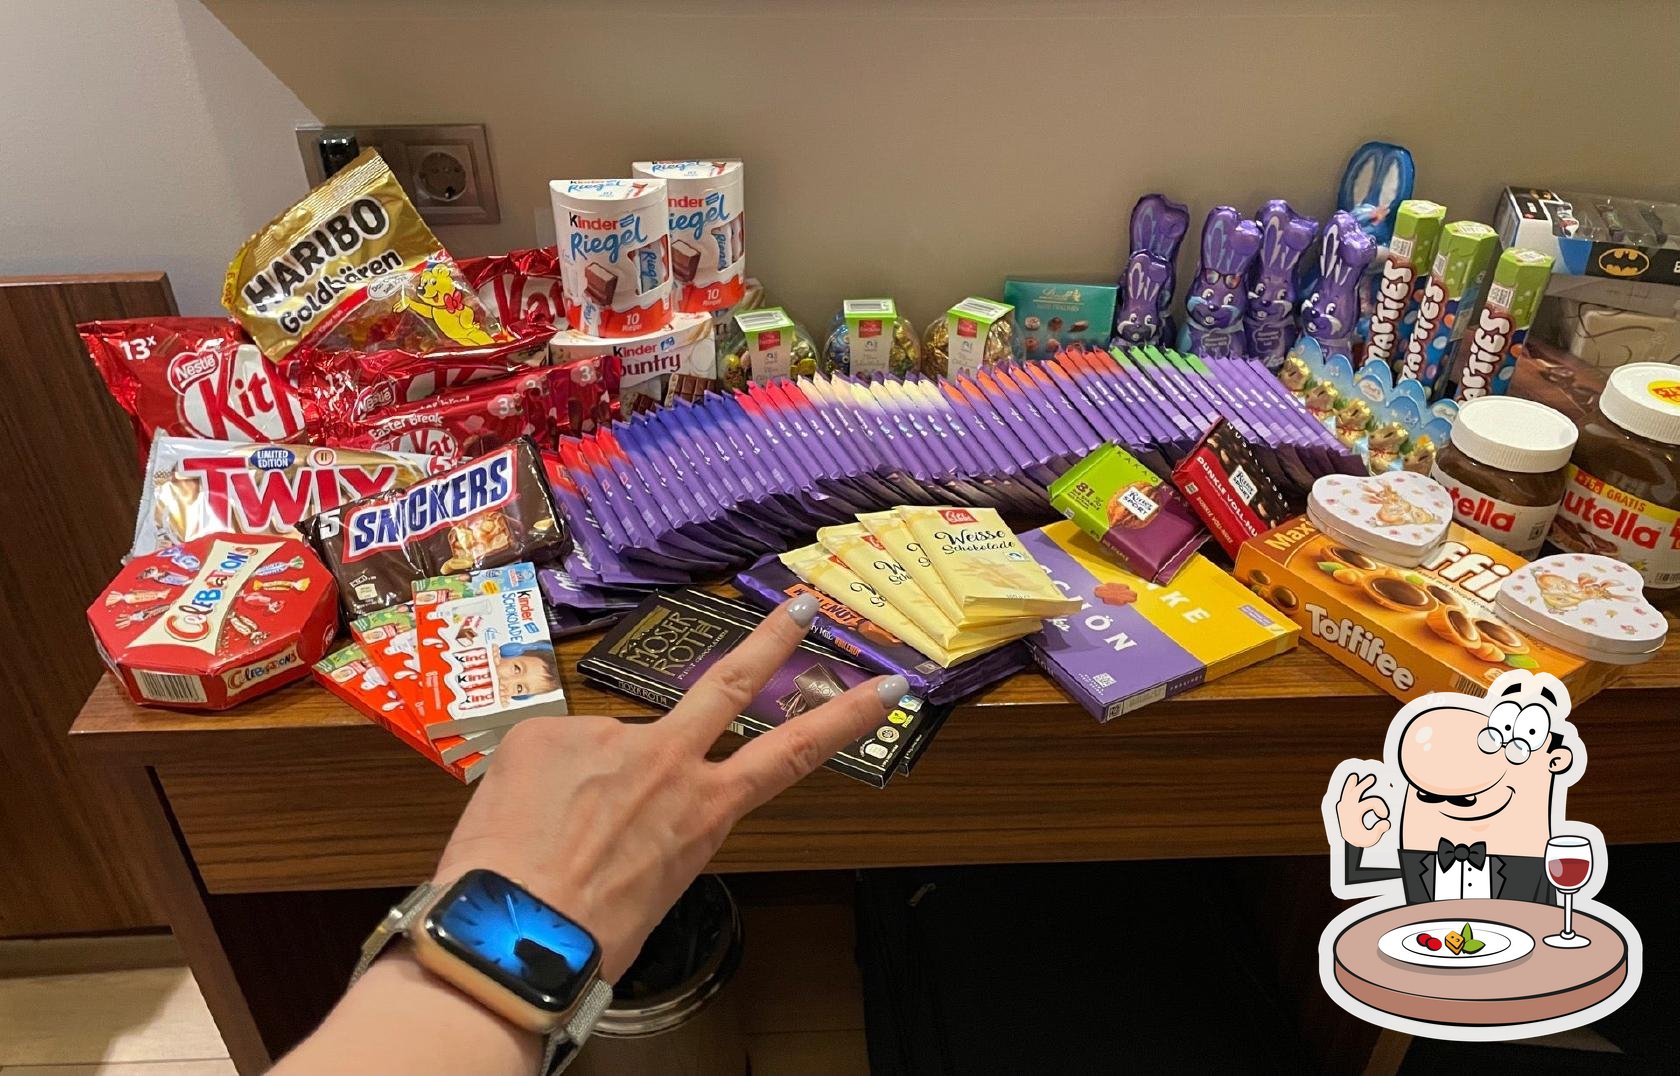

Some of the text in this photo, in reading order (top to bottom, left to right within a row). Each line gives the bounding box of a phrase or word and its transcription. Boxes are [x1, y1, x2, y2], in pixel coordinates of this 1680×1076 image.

[668, 196, 704, 208] nder
[668, 193, 730, 240] iegel
[244, 198, 388, 312] HARIBO
[570, 215, 648, 263] Riegel
[280, 250, 402, 334] Goldbären
[626, 313, 640, 325] 10
[620, 353, 682, 377] ountry
[257, 449, 289, 459] LIMITED
[257, 458, 289, 469] EDITION
[1197, 456, 1227, 495] DUNKLE
[354, 456, 508, 551] SNICKERS
[1448, 486, 1517, 533] tella
[1564, 490, 1662, 550] utella
[1606, 489, 1648, 513] GRATIS
[934, 528, 1006, 546] Weisse
[942, 541, 1015, 555] Schokolade
[501, 592, 524, 642] SCHOKOLADE
[625, 611, 698, 667] MOSER
[651, 619, 722, 678] ROTH
[1304, 602, 1416, 692] Toffifee
